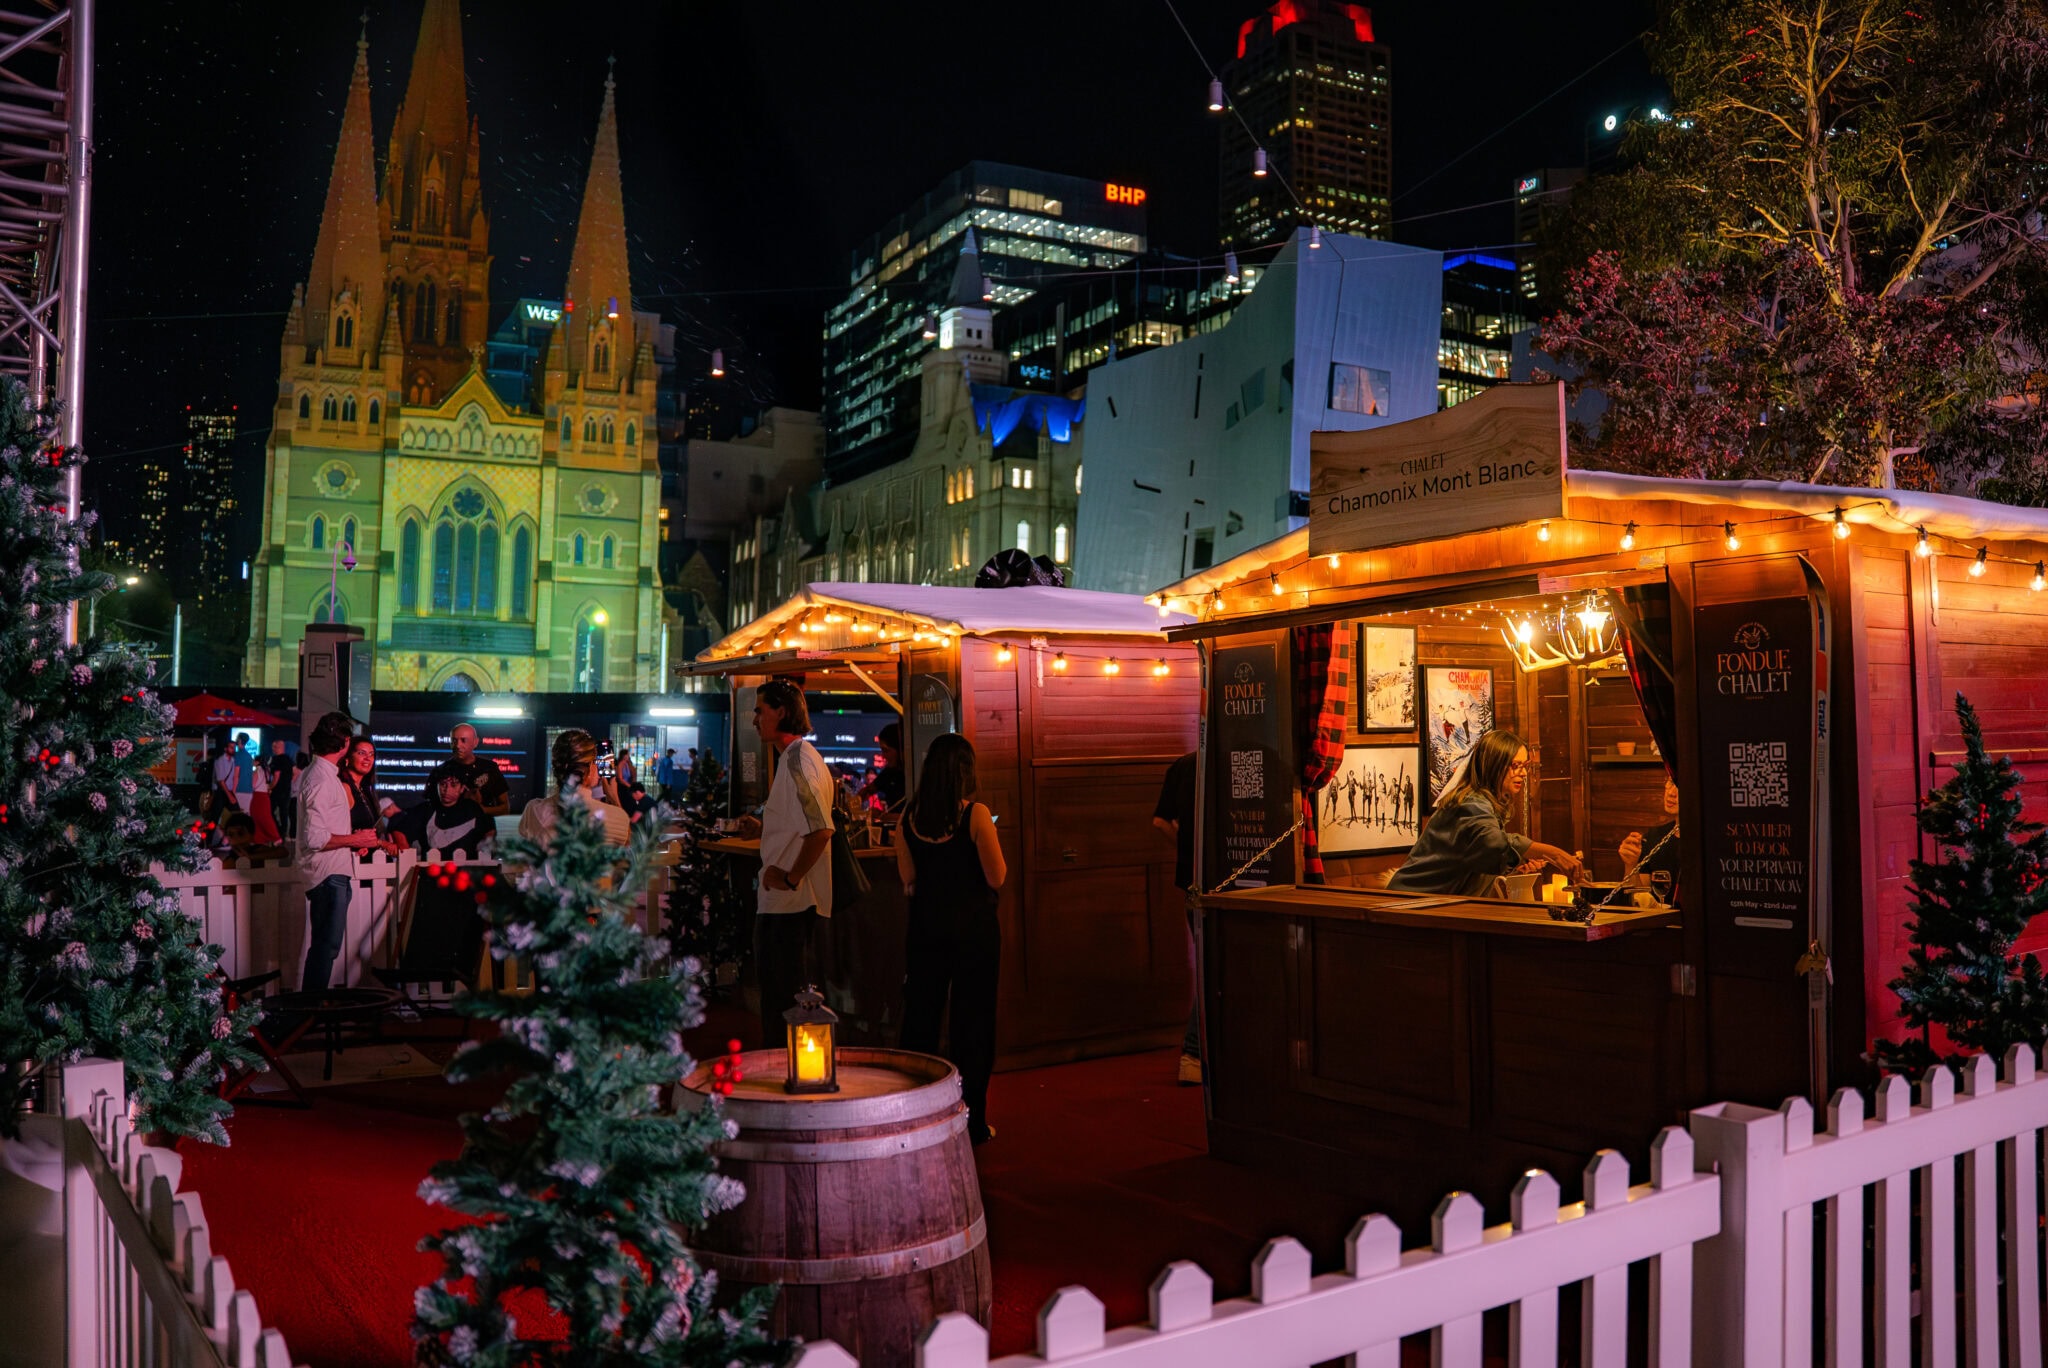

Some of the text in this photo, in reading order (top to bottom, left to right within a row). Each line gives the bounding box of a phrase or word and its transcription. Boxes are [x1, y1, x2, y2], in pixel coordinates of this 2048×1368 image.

[1106, 183, 1146, 206] BHP
[526, 304, 562, 321] WES
[1401, 453, 1445, 475] CHALET
[1328, 460, 1536, 515] Chamonix Mont Blanc
[1717, 649, 1790, 673] FONDUE
[1225, 682, 1266, 700] FONDUE
[1718, 671, 1791, 695] CHALET
[1225, 698, 1266, 716] CHALET
[1753, 841, 1791, 856] BOOK
[1719, 858, 1754, 873] YOUR
[1721, 876, 1804, 893] CHALET NOW
